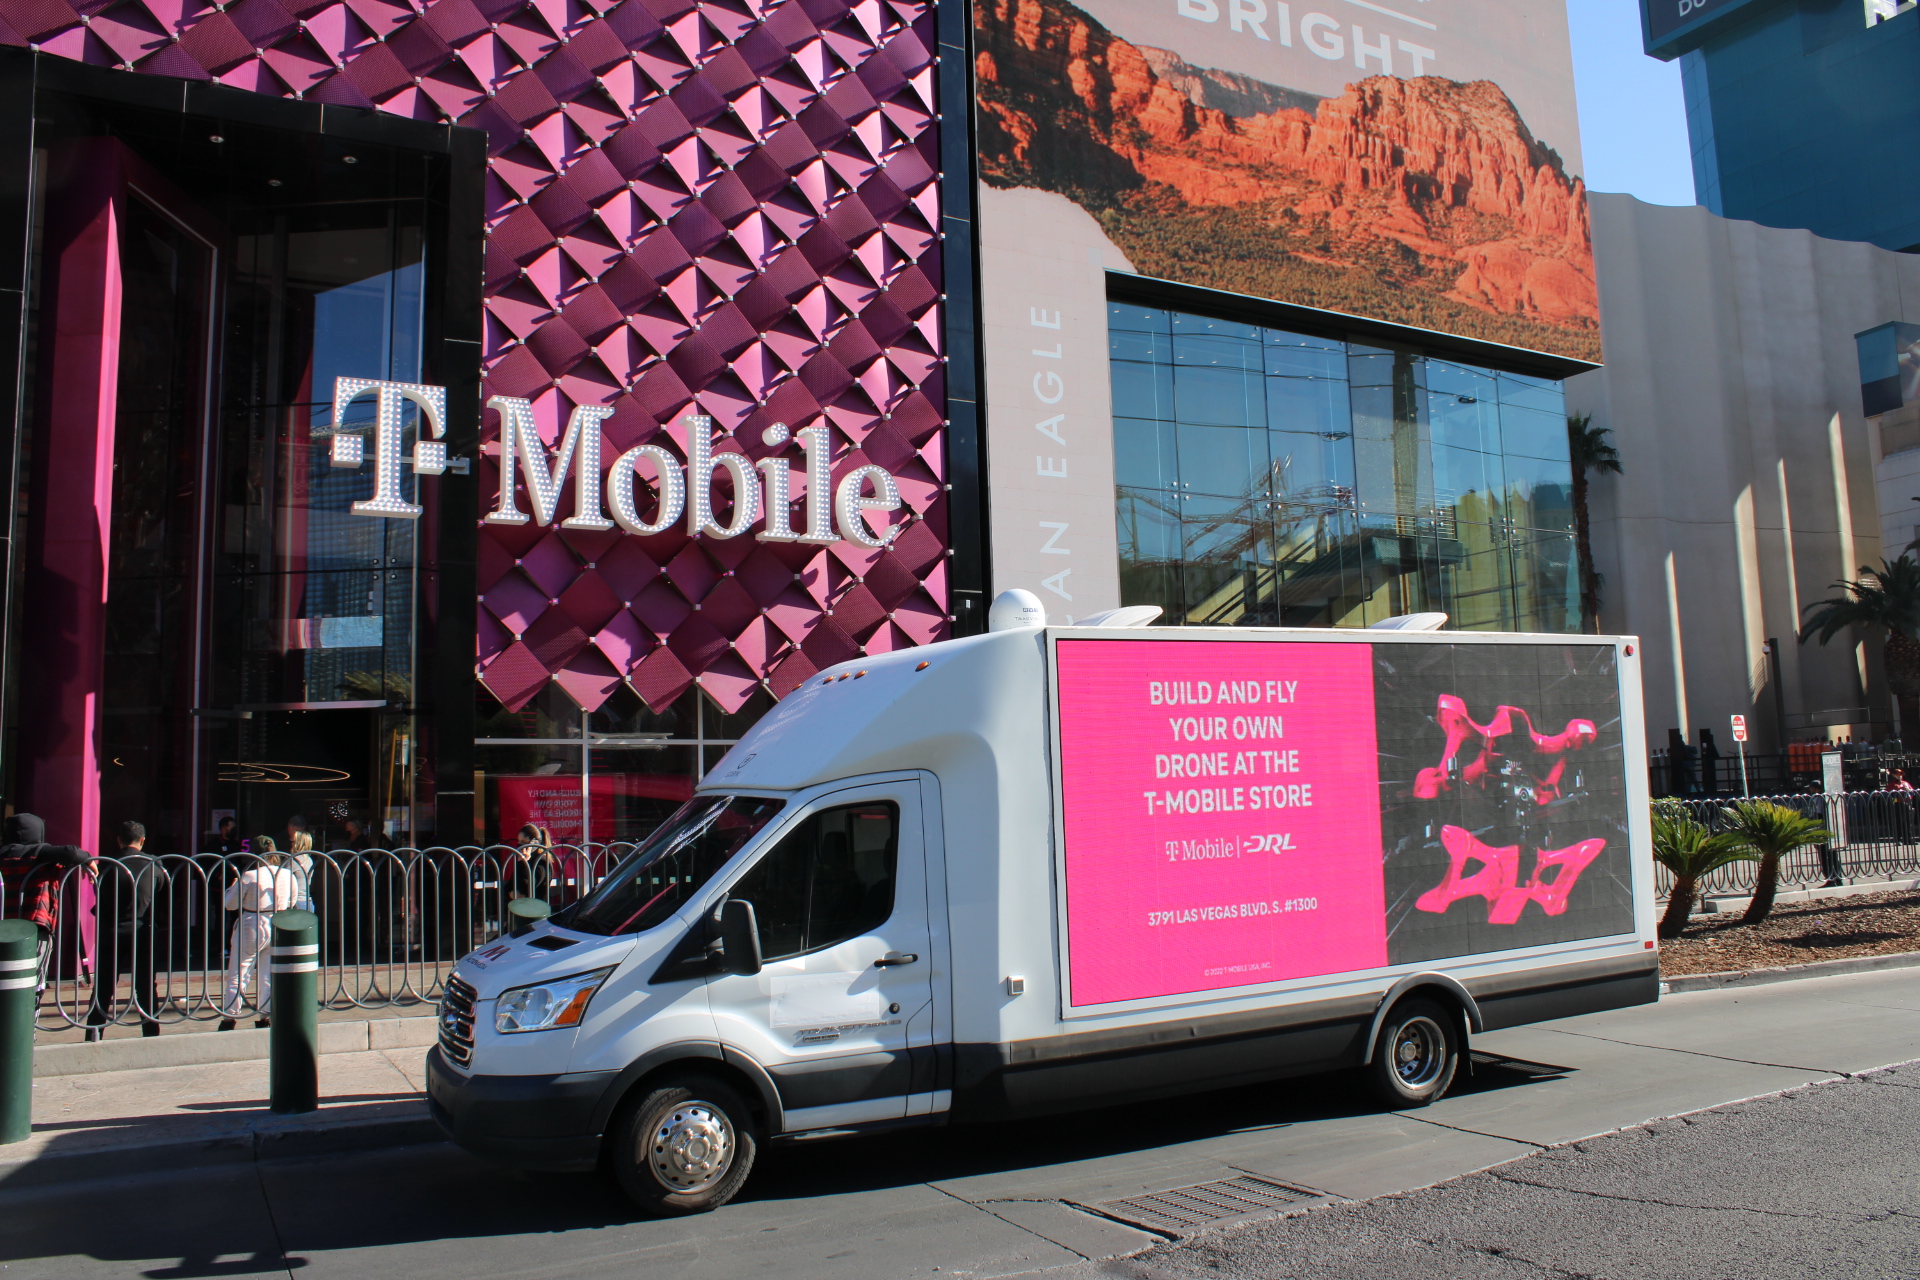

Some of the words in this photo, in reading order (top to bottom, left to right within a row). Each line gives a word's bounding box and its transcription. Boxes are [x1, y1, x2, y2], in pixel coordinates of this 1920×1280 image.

[1030, 307, 1068, 478] EAGLE
[331, 376, 446, 519] T
[485, 395, 900, 549] Mobile
[1150, 681, 1212, 705] BUILD
[1217, 681, 1261, 704] AND
[1266, 681, 1297, 703] FLY
[1169, 717, 1228, 741] YOUR
[1232, 716, 1283, 740] OWN
[1155, 752, 1229, 778] DRONE
[1233, 751, 1258, 775] AT
[1261, 750, 1299, 773] THE
[1144, 787, 1244, 815] T-MOBILE
[1249, 784, 1312, 810] STORE
[1166, 841, 1179, 861] T
[1182, 838, 1233, 860] Mobile
[1148, 910, 1174, 926] 3791
[1177, 908, 1198, 923] LAS
[1200, 904, 1238, 921] VEGAS
[1240, 902, 1271, 917] BLVD.
[1272, 901, 1282, 914] S.
[1284, 897, 1317, 912] #1300
[1224, 964, 1248, 973] T-MOBILE
